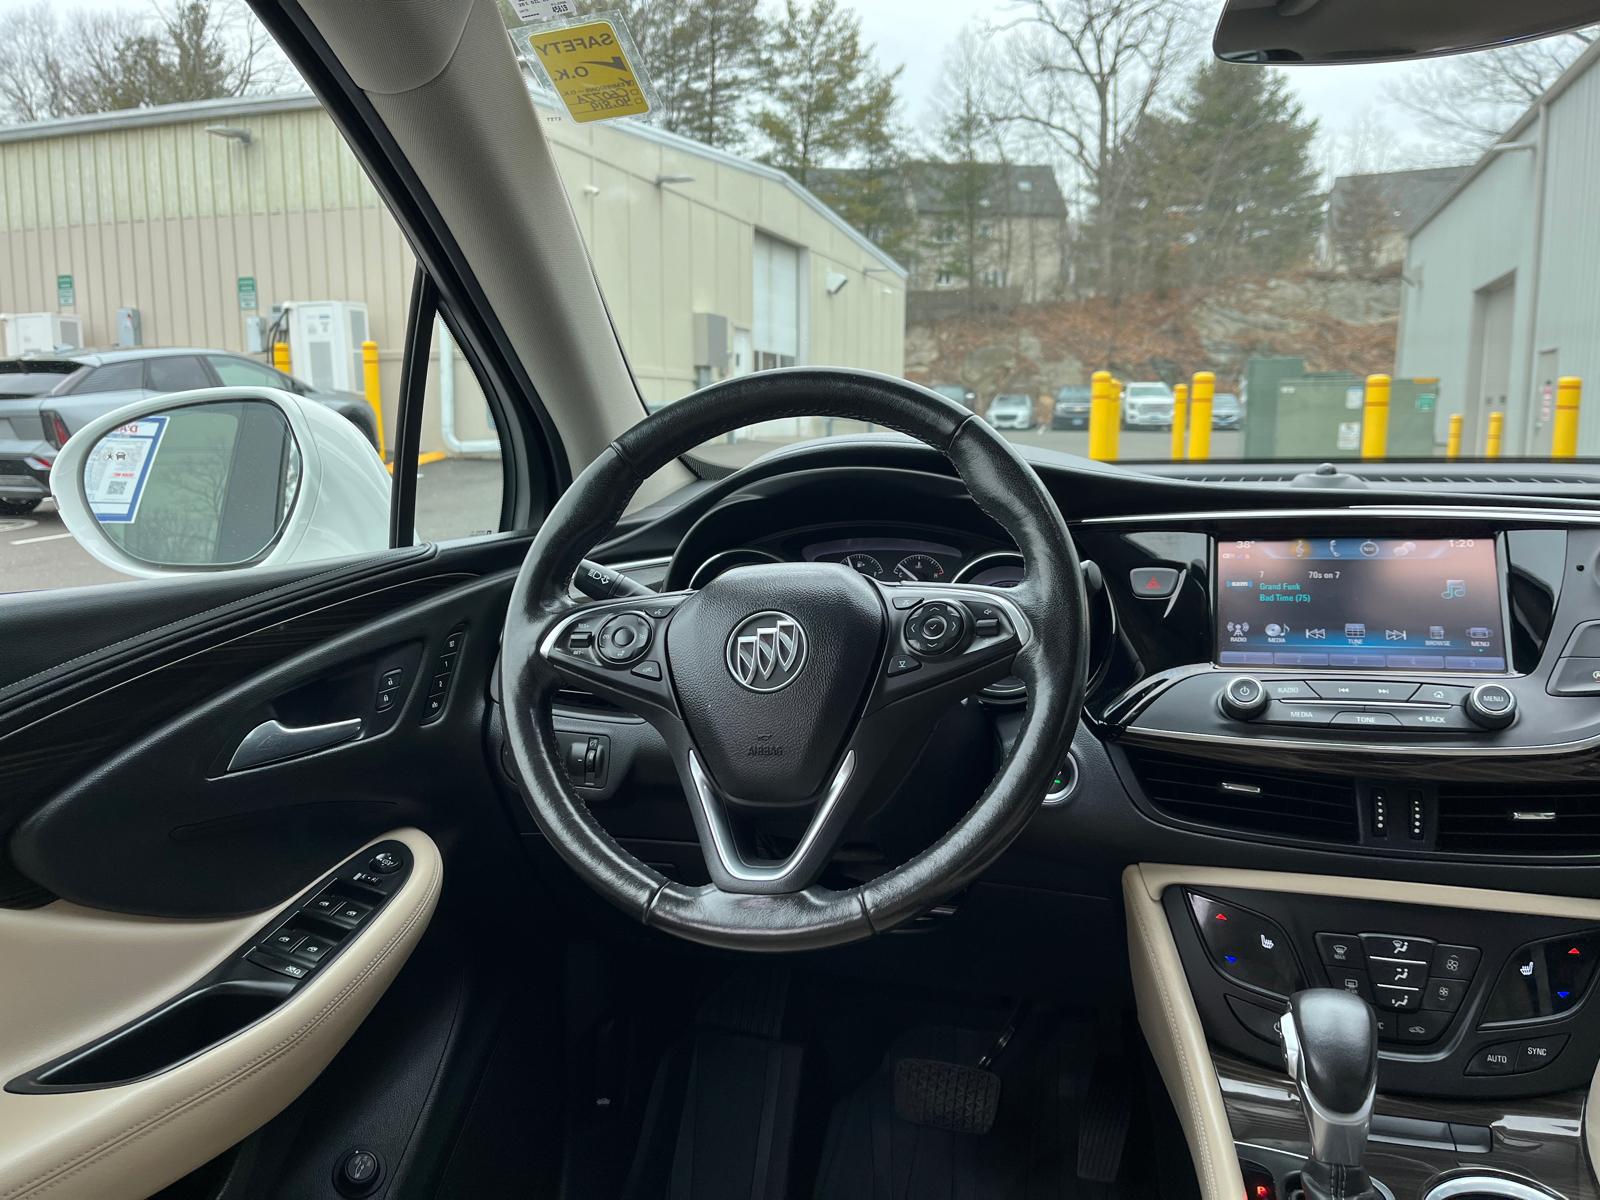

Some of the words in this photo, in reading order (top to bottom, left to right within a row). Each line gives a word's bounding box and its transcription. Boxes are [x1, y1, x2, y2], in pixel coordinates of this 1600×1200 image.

[1448, 539, 1475, 548] 1:20
[1308, 571, 1323, 579] 70s
[1335, 571, 1341, 579] 7
[1259, 582, 1282, 590] Grand
[1283, 582, 1301, 590] Funk
[1259, 594, 1275, 602] Bad
[1275, 594, 1294, 602] Time
[1295, 594, 1311, 603] (75)
[1425, 715, 1446, 723] BACK
[748, 745, 783, 756] AIRBAG
[1527, 1046, 1547, 1056] SYNC
[1486, 1054, 1507, 1064] AUTO
[1257, 1186, 1266, 1196] P
